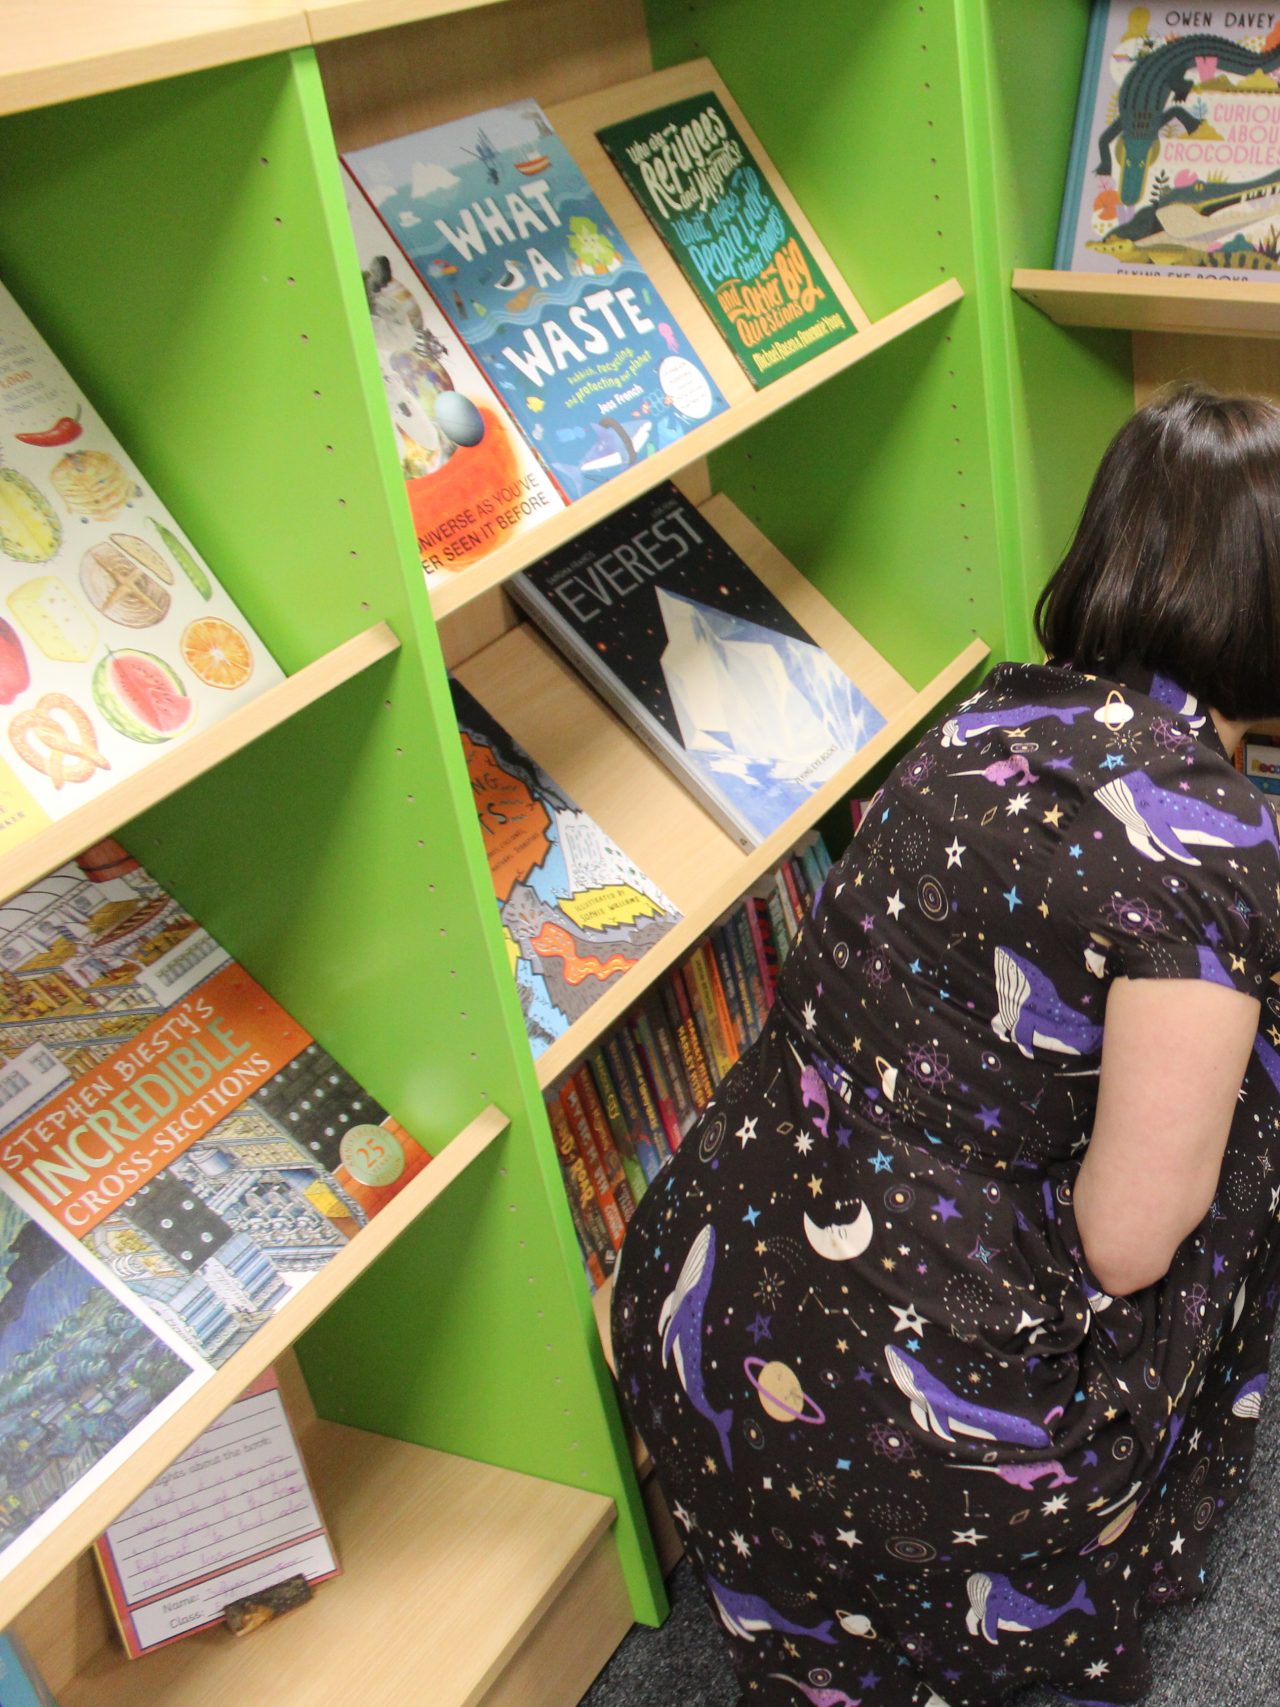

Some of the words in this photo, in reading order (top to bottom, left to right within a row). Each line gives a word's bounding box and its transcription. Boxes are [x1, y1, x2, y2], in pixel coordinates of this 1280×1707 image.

[1165, 10, 1213, 27] OWEN
[1224, 12, 1275, 29] DAVEY
[625, 139, 651, 165] Who
[639, 106, 728, 220] Refugees
[434, 179, 562, 263] WHAT
[680, 189, 702, 211] and
[526, 247, 565, 289] A
[774, 237, 826, 313] Big
[501, 287, 656, 388] WASTE
[736, 299, 805, 348] Questions
[613, 383, 645, 410] French
[417, 508, 477, 554] NIVERSE
[476, 498, 496, 518] AS
[492, 473, 540, 506] YOU'VE
[443, 530, 482, 561] SEEN
[480, 521, 496, 539] IT
[495, 491, 550, 530] BEFORE
[553, 506, 705, 624] EVEREST
[2, 1077, 115, 1172] STEPHEN
[117, 996, 215, 1083] BIESTY'S
[20, 1016, 251, 1207] INCREDIBLE
[63, 1051, 273, 1227] CROSS-SECTIONS
[355, 1137, 386, 1170] 25
[570, 1157, 595, 1209] ROAR
[587, 1143, 609, 1195] MUTH
[189, 1455, 222, 1475] about
[223, 1449, 242, 1464] the
[163, 1593, 200, 1613] Name:
[169, 1610, 206, 1629] Class:
